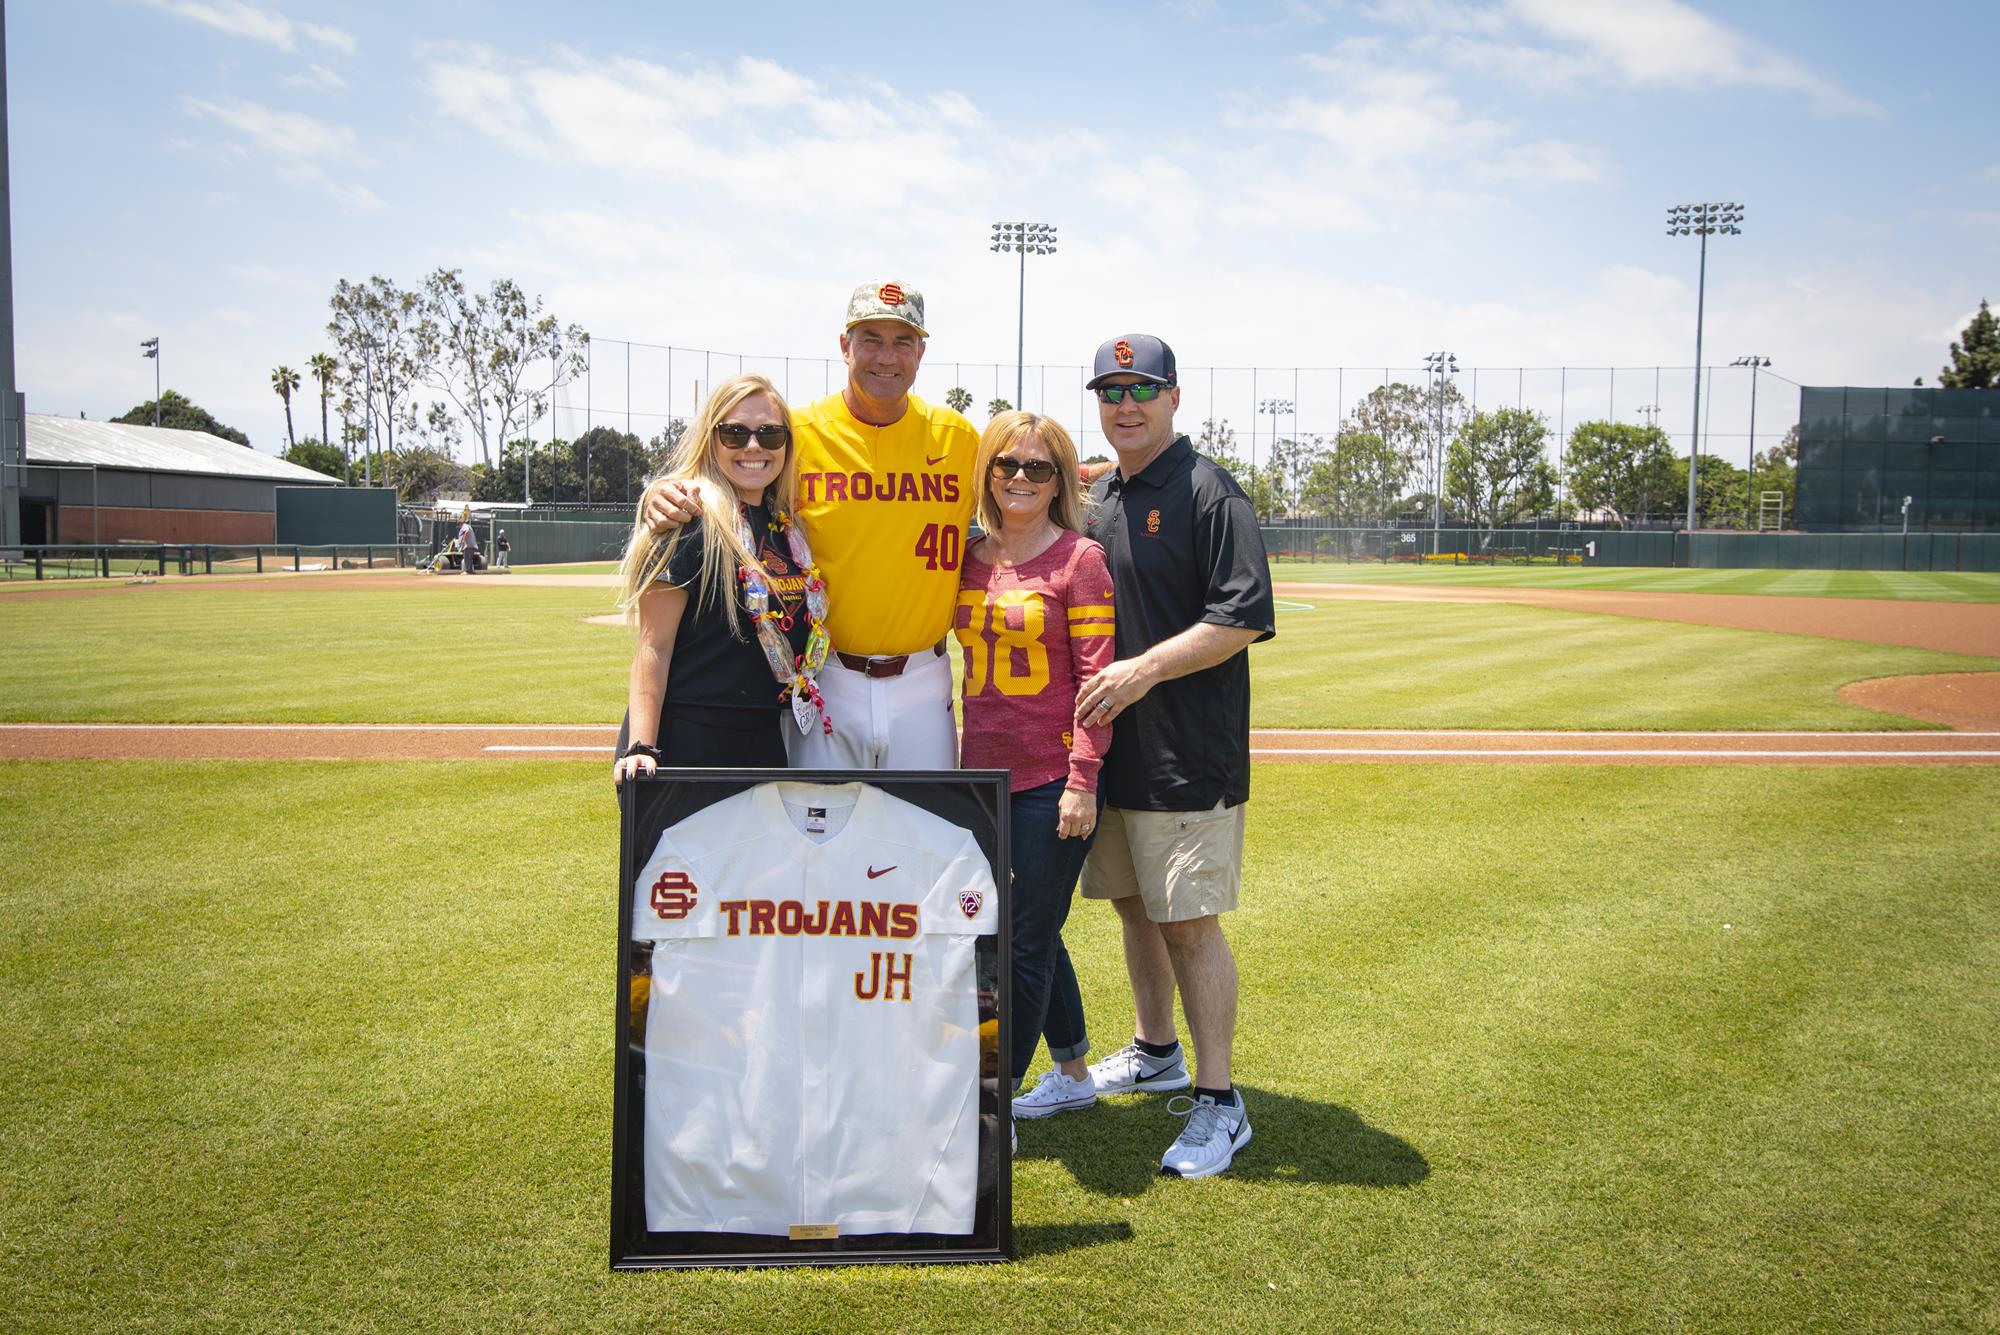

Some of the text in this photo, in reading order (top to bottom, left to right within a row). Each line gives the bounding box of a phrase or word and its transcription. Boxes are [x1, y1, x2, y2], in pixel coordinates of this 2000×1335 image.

[800, 471, 960, 503] TROJANS
[914, 522, 960, 572] 40
[1400, 533, 1417, 543] 365
[1585, 540, 1596, 557] 1
[765, 576, 807, 593] TROJAN
[719, 899, 920, 940] TROJANS
[965, 902, 977, 913] 12
[854, 951, 913, 1002] JH
